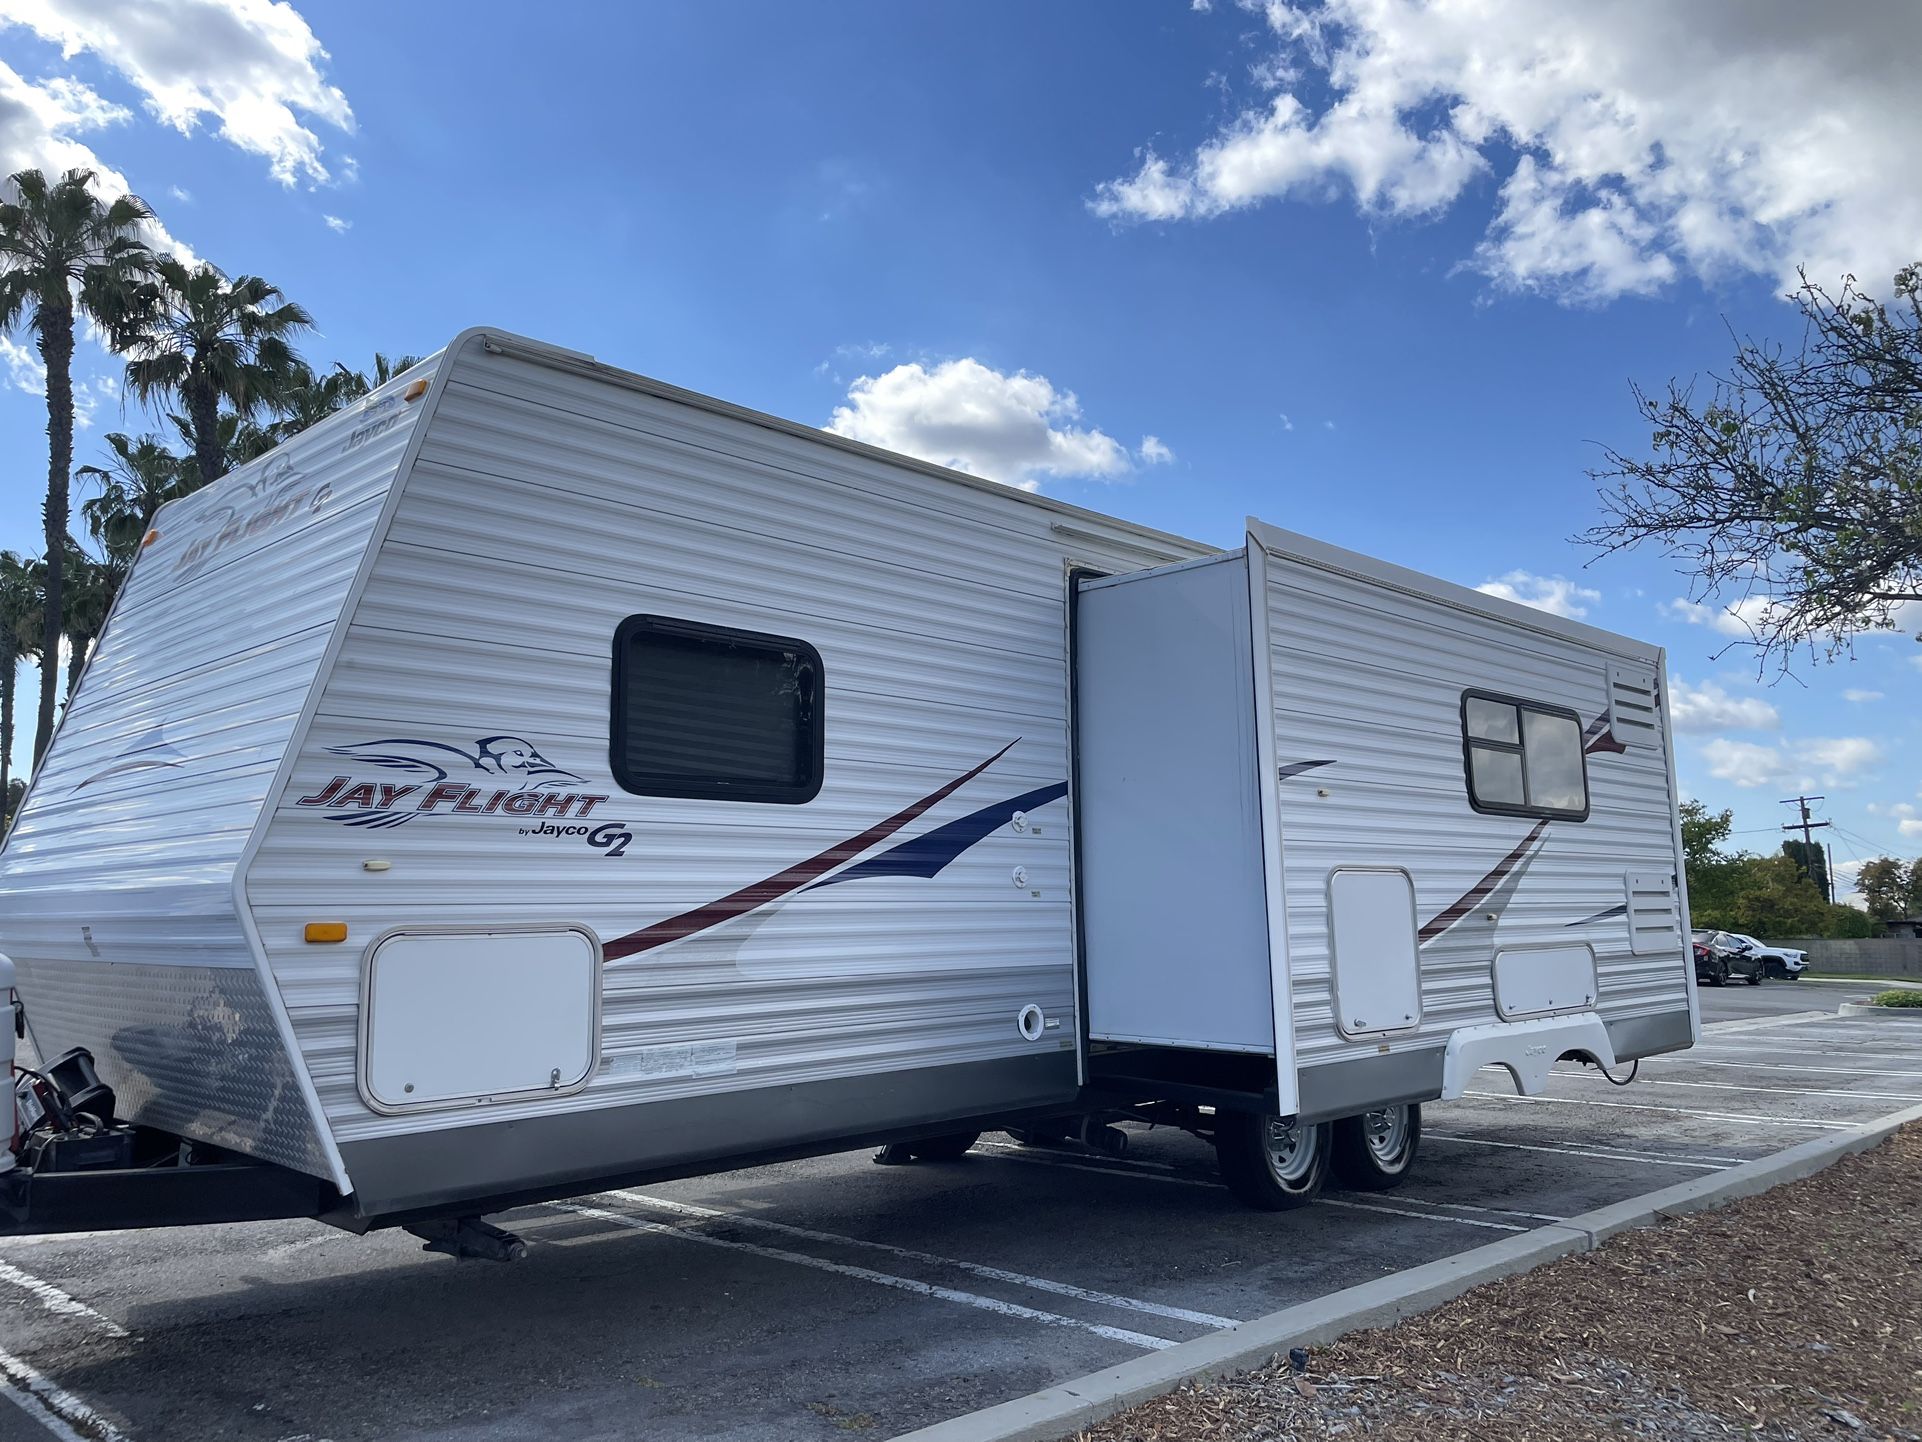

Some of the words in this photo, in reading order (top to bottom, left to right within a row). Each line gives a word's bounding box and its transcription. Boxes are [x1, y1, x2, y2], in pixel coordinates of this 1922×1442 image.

[296, 776, 421, 808] JAY
[417, 782, 610, 817] FLIGHT
[518, 827, 530, 836] by
[531, 821, 589, 838] Jayco
[586, 823, 633, 857] G2
